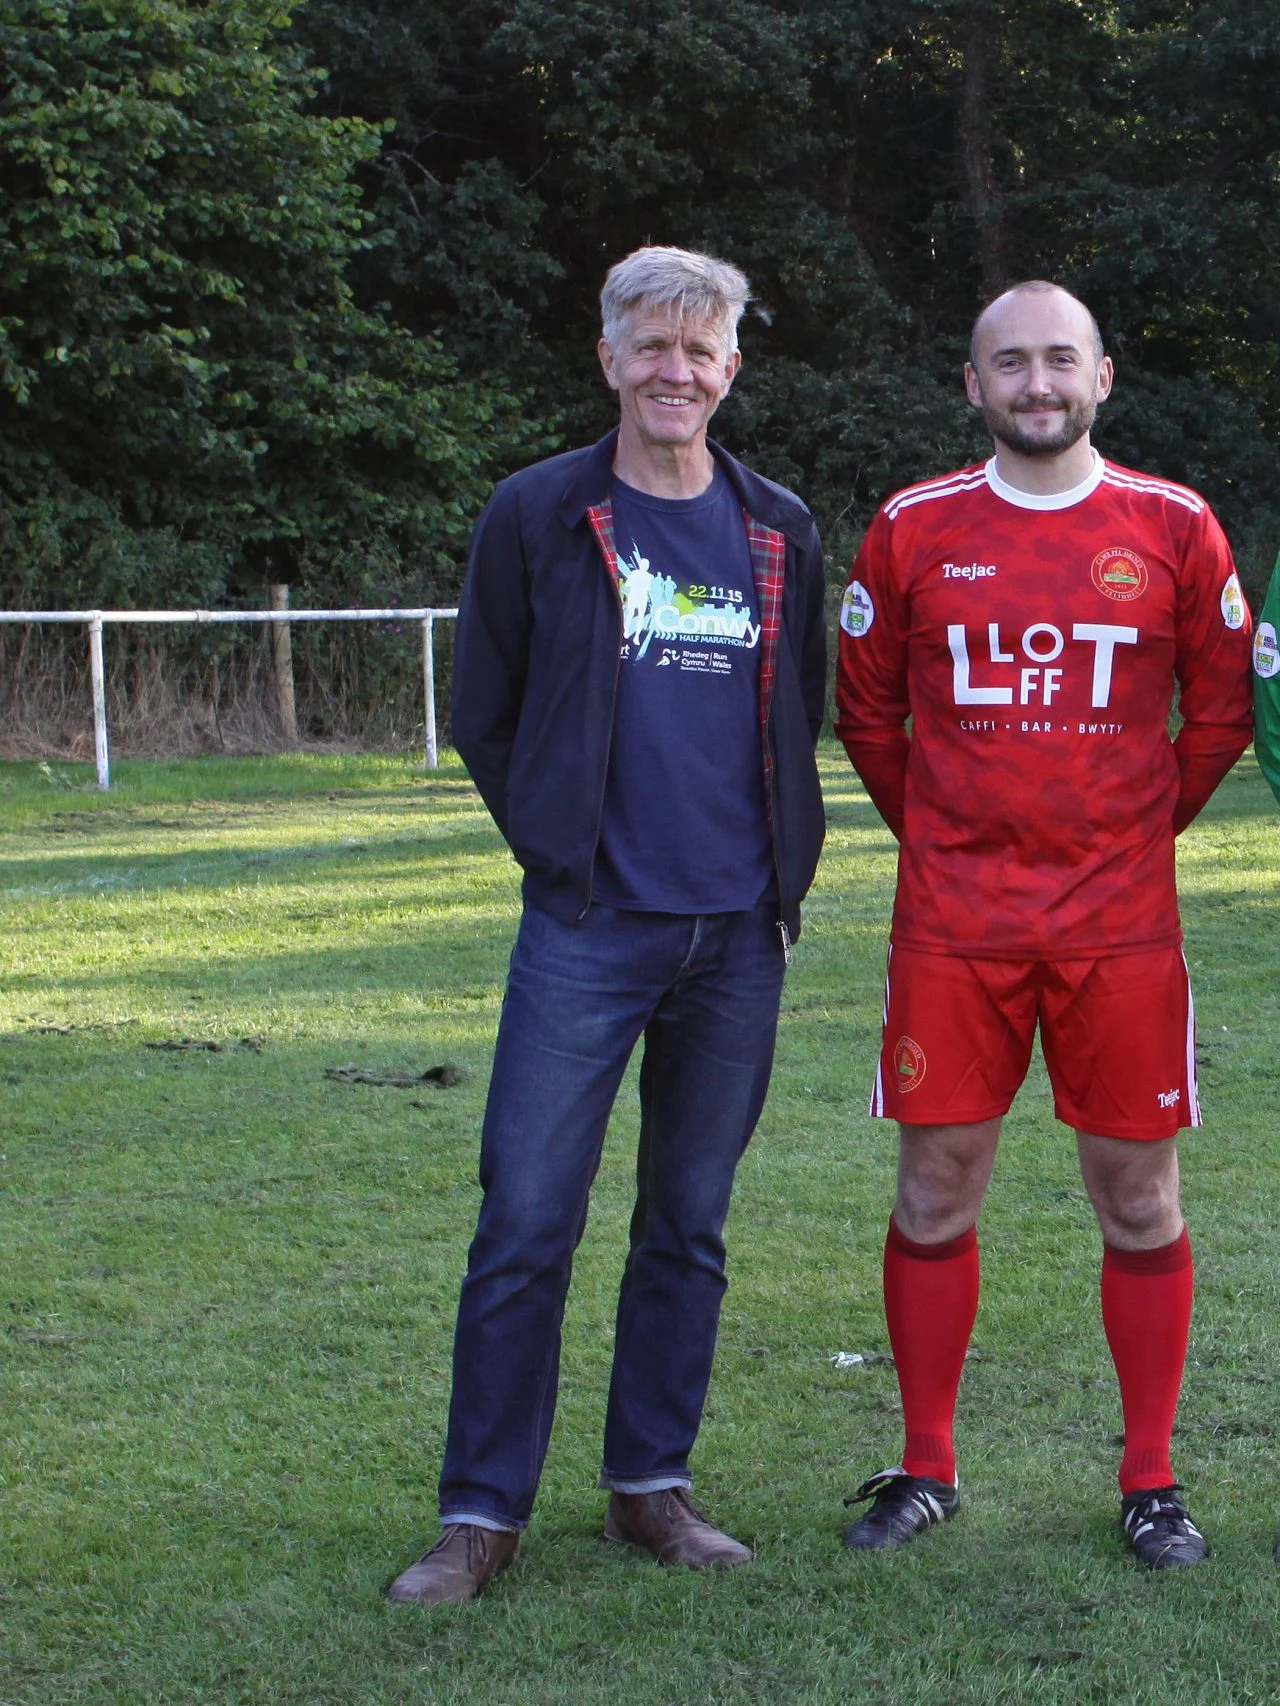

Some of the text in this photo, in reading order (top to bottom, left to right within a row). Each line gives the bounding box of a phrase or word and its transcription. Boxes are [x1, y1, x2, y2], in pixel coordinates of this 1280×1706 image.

[942, 563, 996, 581] Teejac
[688, 584, 743, 603] 22.11.15
[653, 604, 761, 649] Conwy
[680, 634, 746, 648] HALF MARATHON
[960, 721, 1123, 735] CAFFI BAR BWYTY
